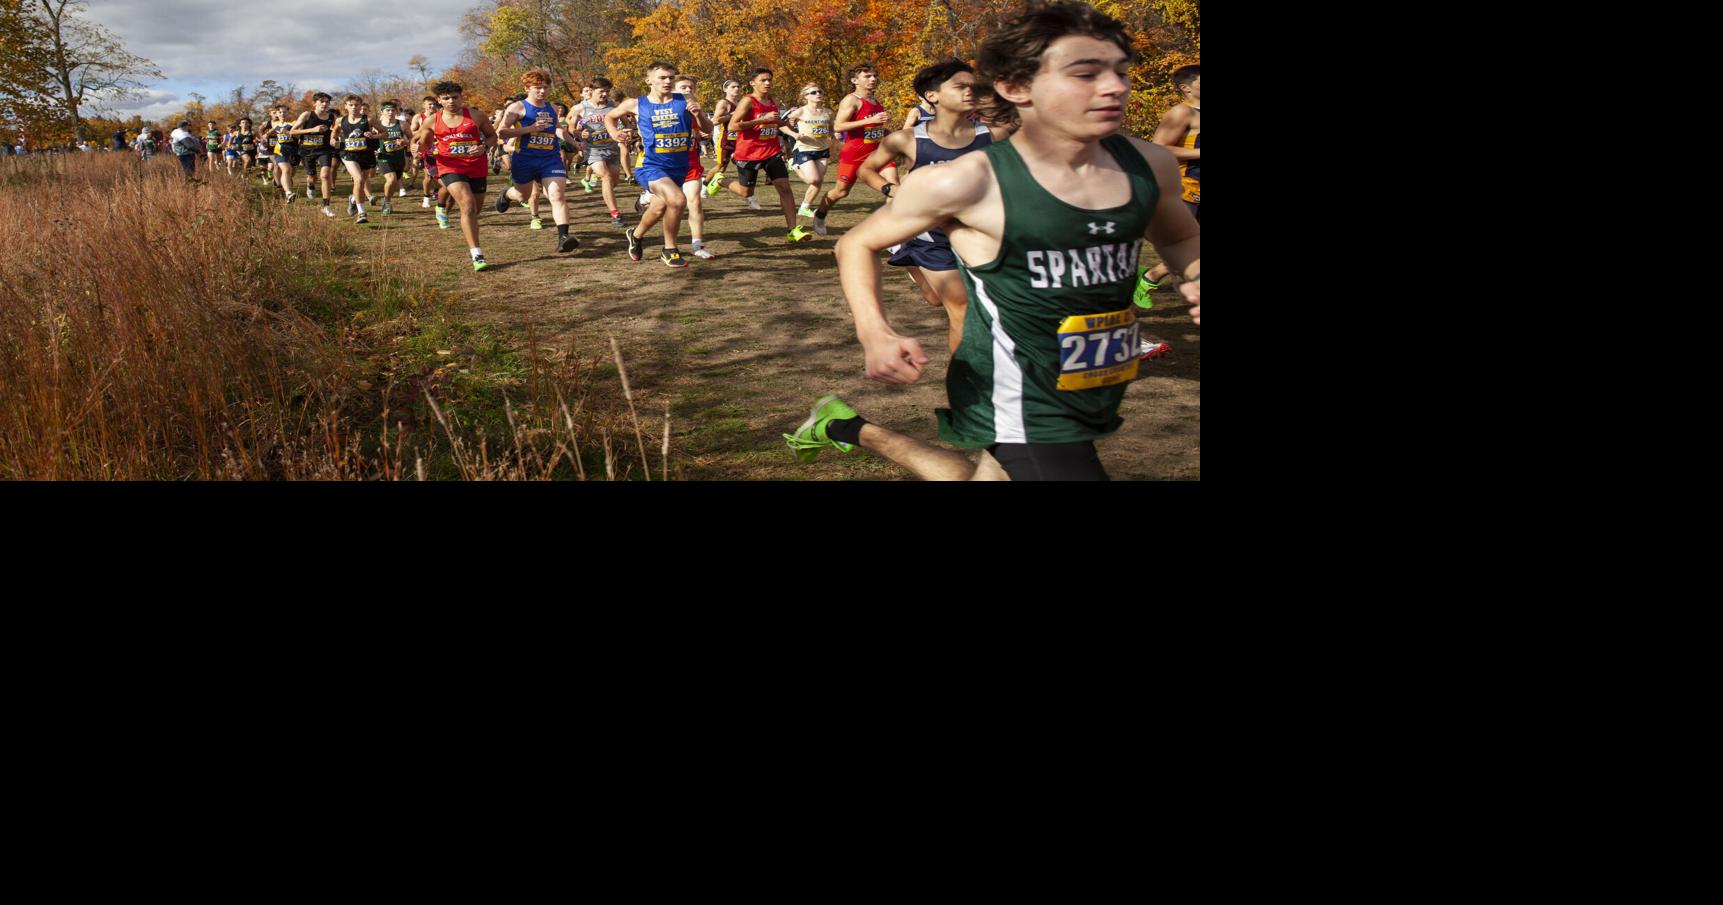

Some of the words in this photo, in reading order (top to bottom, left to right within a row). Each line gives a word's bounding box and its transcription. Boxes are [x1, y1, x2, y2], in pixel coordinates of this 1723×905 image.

[529, 136, 554, 145] 3397
[591, 132, 608, 141] 247
[345, 140, 366, 148] 3271
[656, 137, 687, 148] 3392
[449, 145, 473, 154] 287
[1061, 322, 1142, 371] 2732
